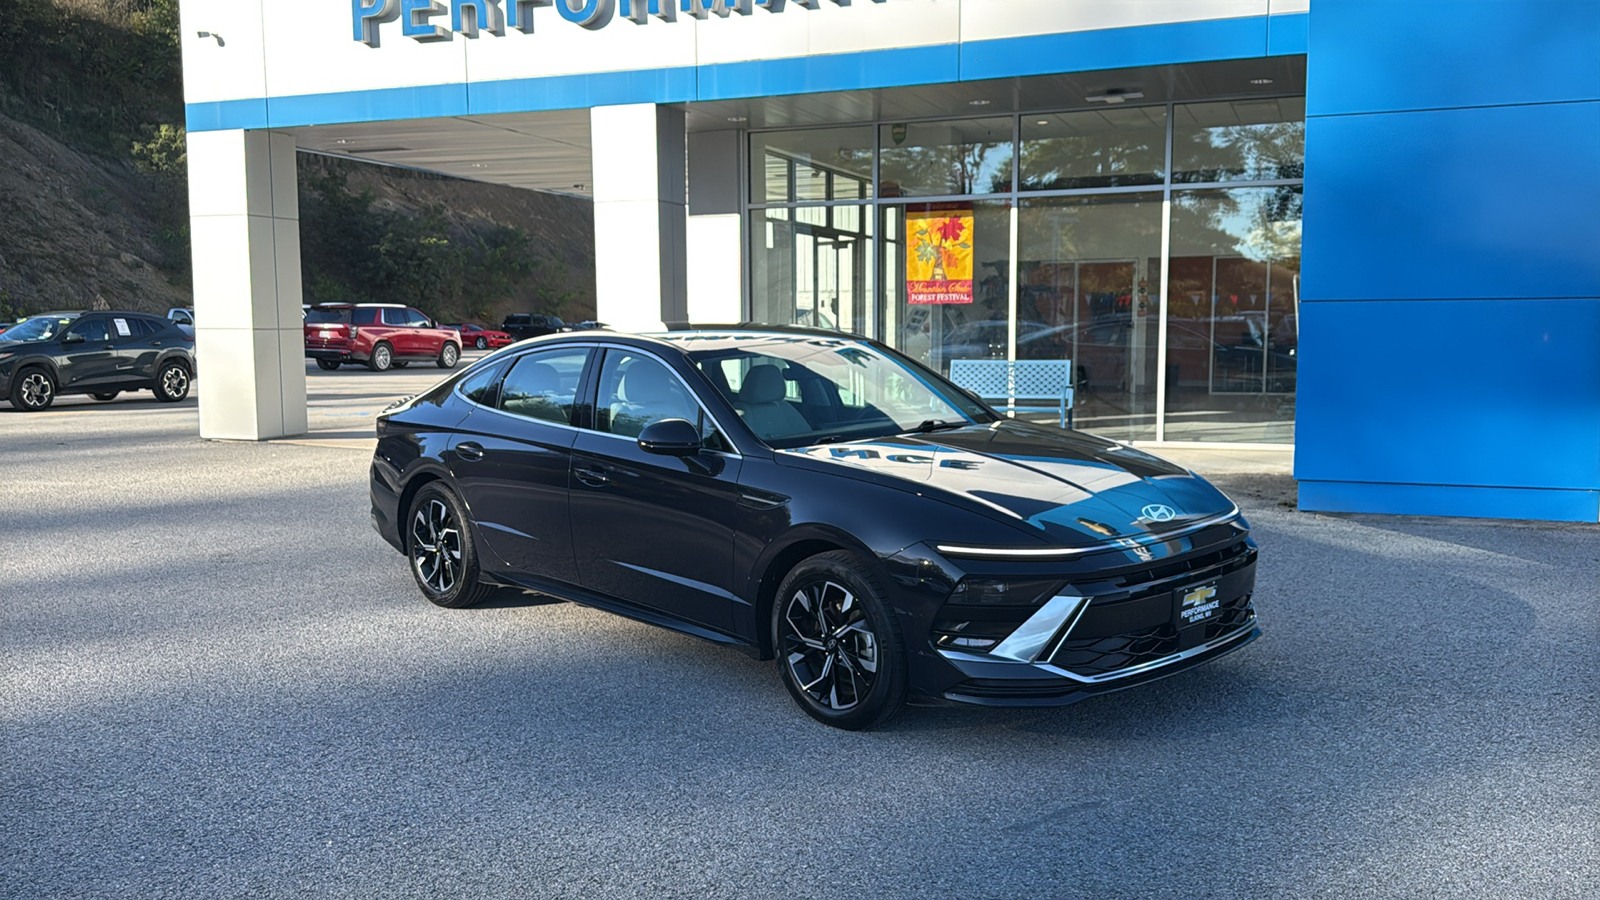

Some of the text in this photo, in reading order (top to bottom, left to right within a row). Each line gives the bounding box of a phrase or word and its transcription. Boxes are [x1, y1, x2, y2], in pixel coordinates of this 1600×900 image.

[911, 293, 970, 301] FOREST FESTIVAL
[1180, 600, 1220, 619] PERFORMANCE
